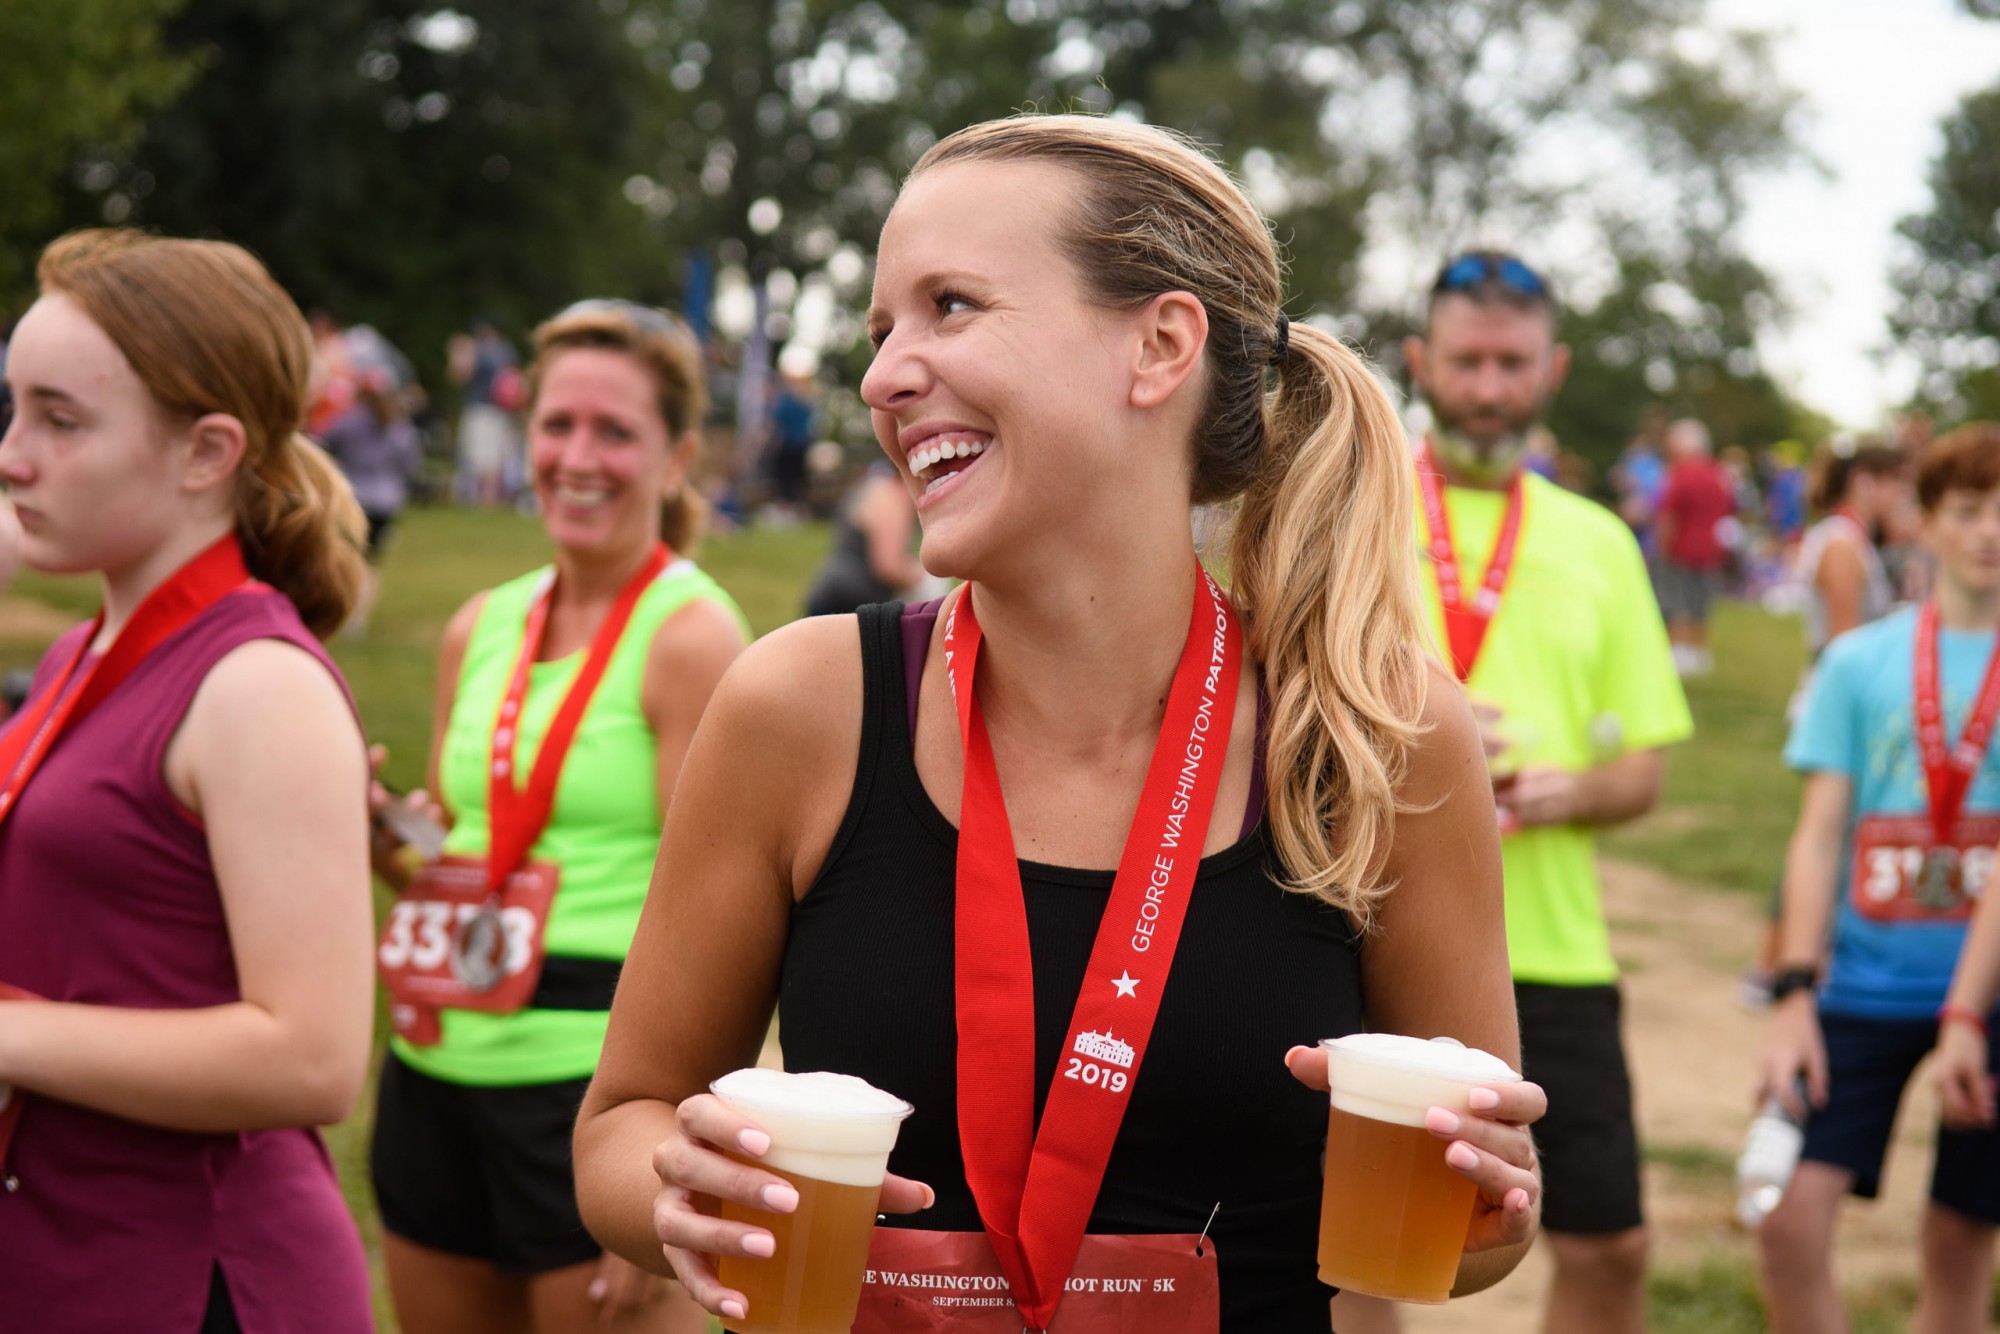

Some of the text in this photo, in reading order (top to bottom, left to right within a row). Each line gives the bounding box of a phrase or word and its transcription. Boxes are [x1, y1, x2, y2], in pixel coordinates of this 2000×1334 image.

[1131, 854, 1174, 953] GEORGE
[1160, 695, 1214, 848] WASHINGTON
[1205, 601, 1227, 694] PATRIOT
[378, 899, 537, 975] 338
[1064, 1057, 1128, 1093] 2019
[880, 1271, 1010, 1291] WASHINGTON
[1153, 1277, 1176, 1293] 5K
[932, 1296, 1004, 1308] SEPTEMBER
